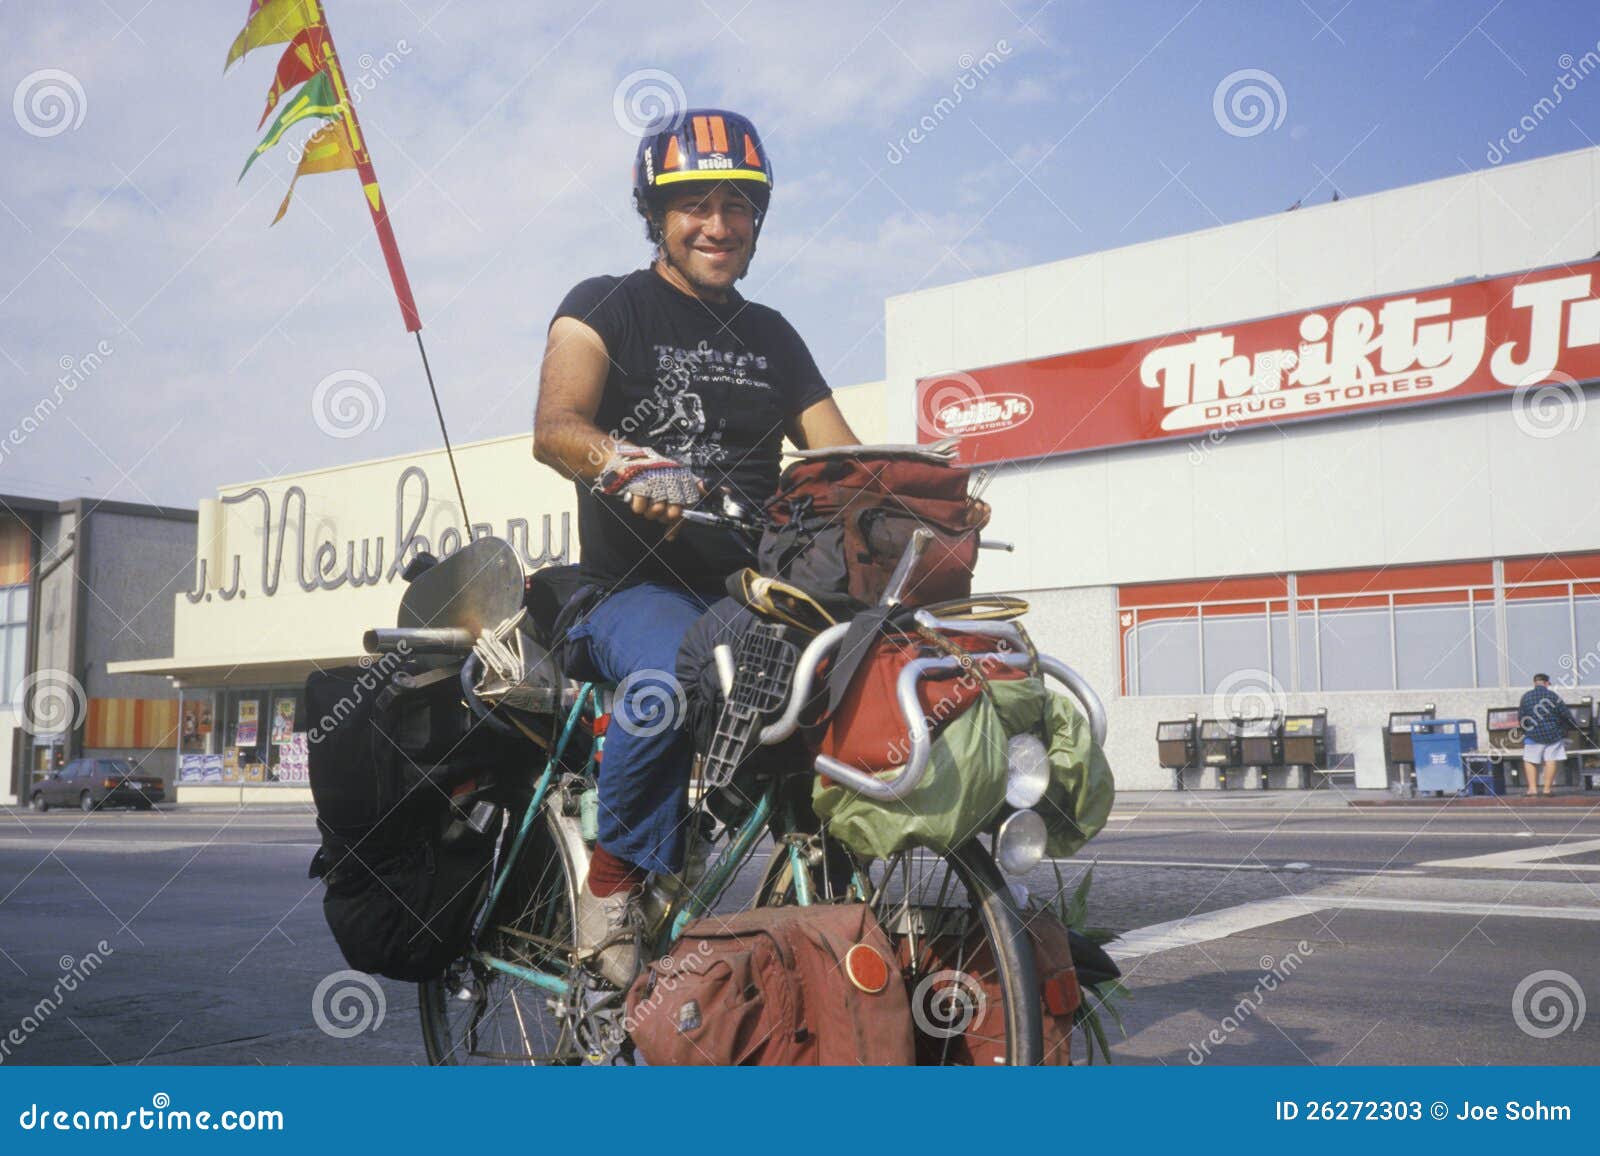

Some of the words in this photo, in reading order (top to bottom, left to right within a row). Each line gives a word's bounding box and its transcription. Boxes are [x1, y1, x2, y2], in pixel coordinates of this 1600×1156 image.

[1140, 298, 1487, 431] Thrifty
[1205, 396, 1286, 420] DRUG
[1303, 375, 1434, 406] STORES
